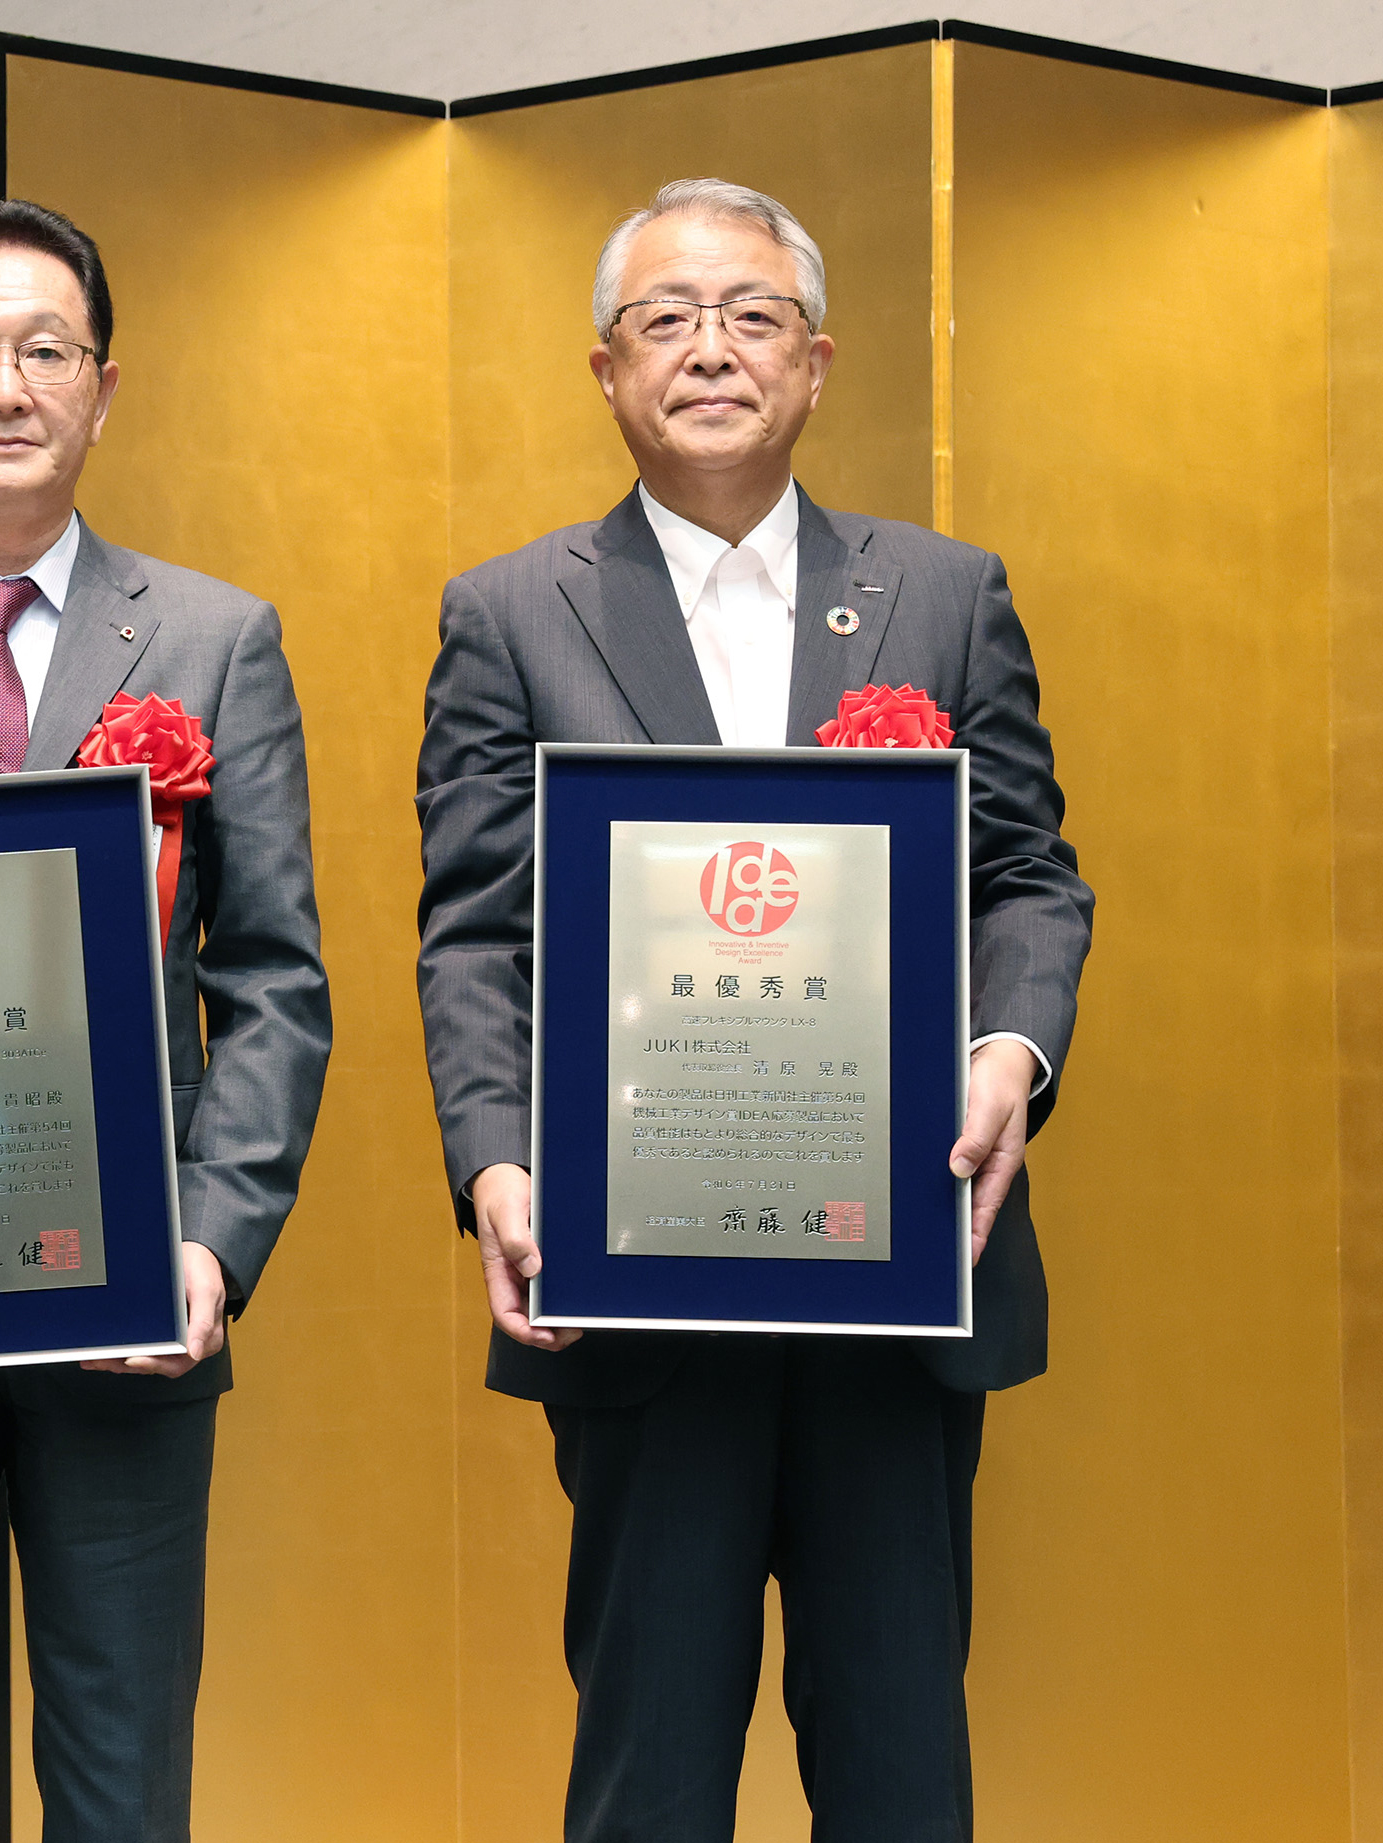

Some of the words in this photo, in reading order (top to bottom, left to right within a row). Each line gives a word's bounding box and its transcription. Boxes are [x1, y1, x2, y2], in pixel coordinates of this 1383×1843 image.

[708, 941, 746, 949] Innovative
[748, 941, 754, 949] &
[756, 941, 789, 949] Inventive
[715, 949, 742, 957] Design
[744, 949, 783, 957] Excellence
[671, 974, 828, 1001] 最優秀賞
[643, 1039, 752, 1055] JUKI株式会社
